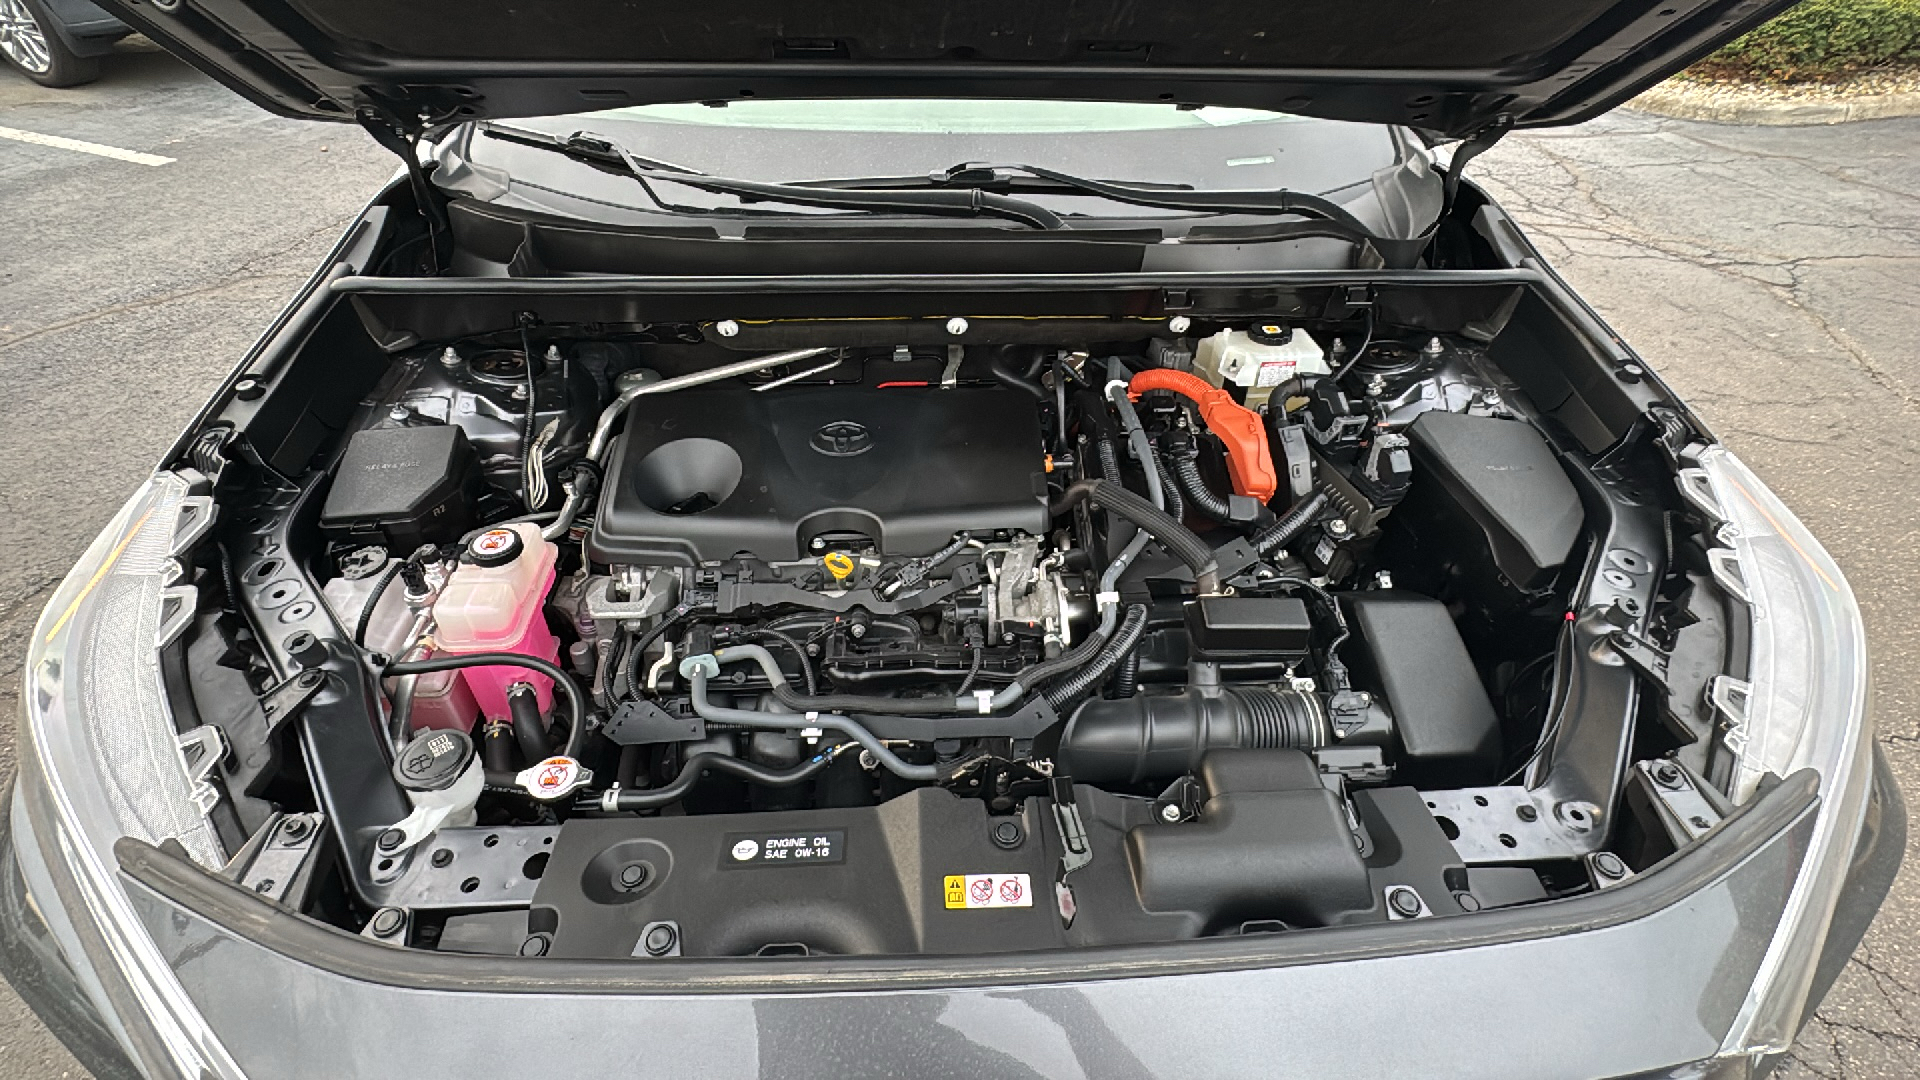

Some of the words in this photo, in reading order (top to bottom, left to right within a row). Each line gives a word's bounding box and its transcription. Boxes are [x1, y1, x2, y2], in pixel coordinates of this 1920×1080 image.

[765, 837, 807, 848] ENGINE
[813, 836, 831, 847] OIL
[764, 849, 788, 859] SAE
[795, 847, 830, 858] 0W-16
